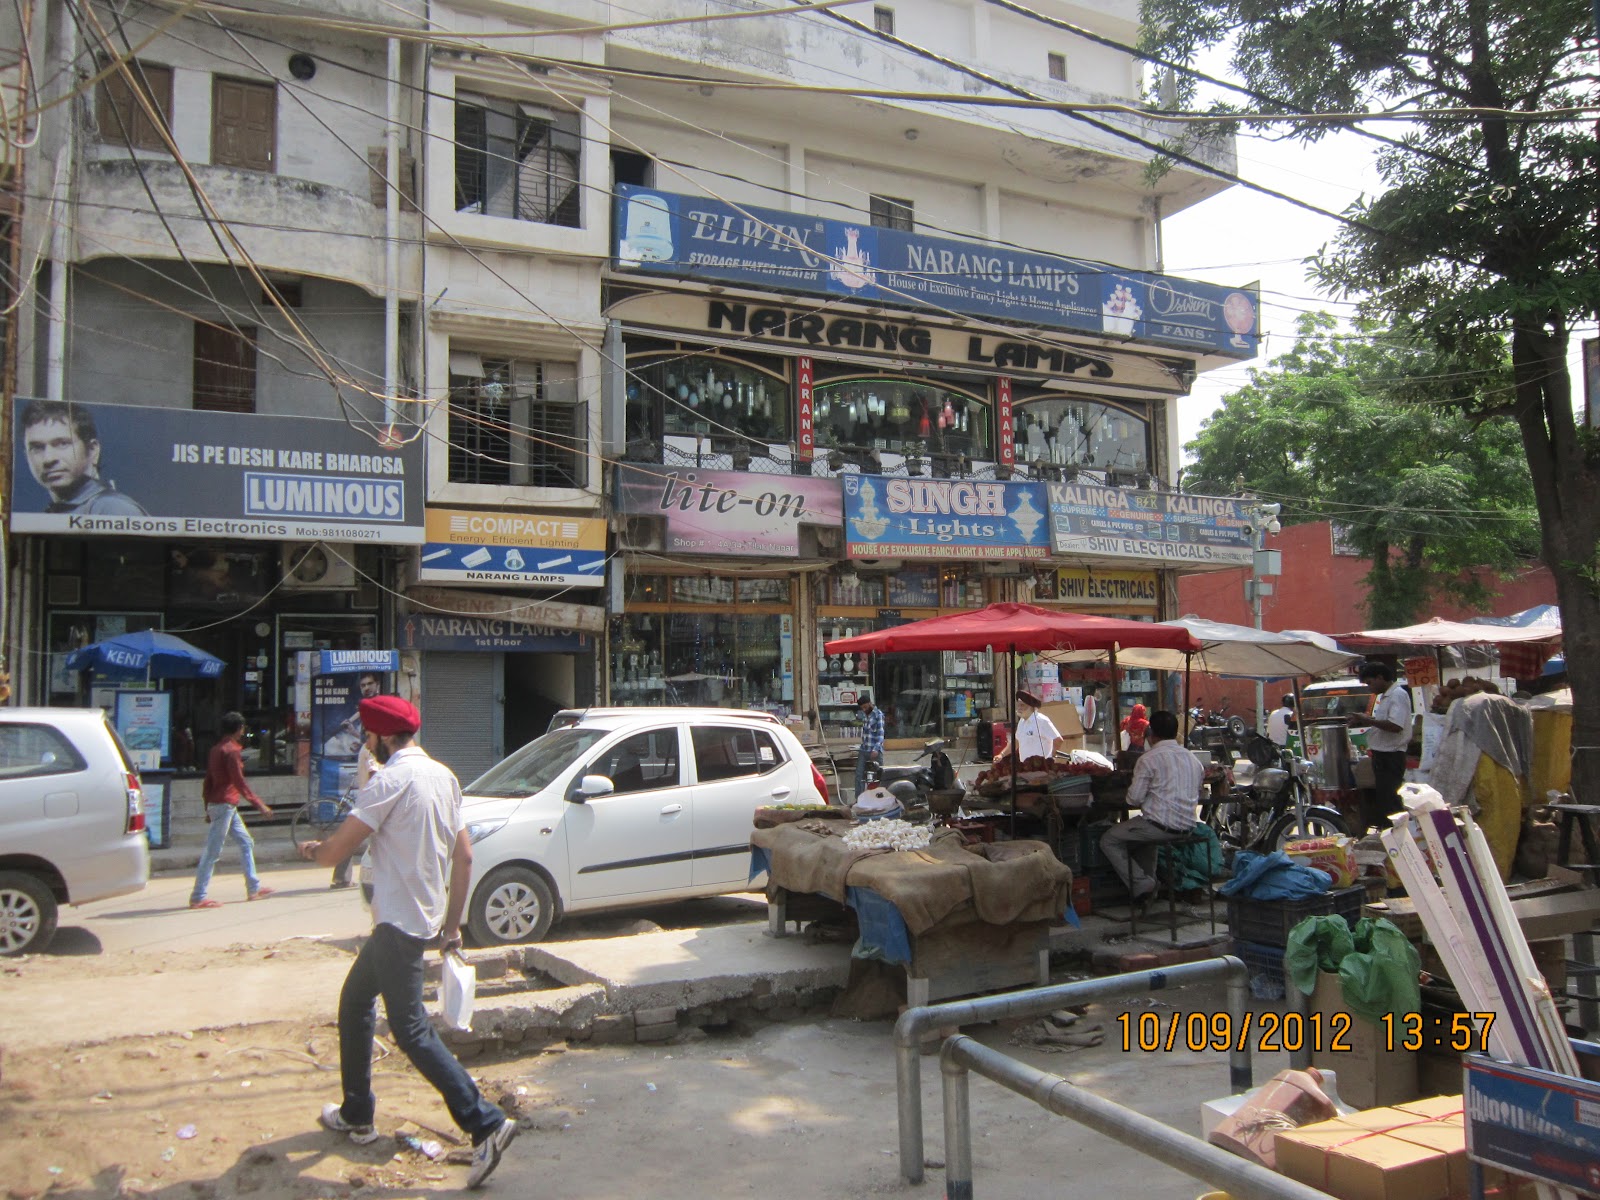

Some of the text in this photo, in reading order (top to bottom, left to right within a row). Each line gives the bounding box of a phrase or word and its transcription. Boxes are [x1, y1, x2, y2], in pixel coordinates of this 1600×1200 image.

[688, 211, 819, 268] ELWIN
[689, 252, 818, 281] STORAGE WATER HEATER
[907, 244, 1079, 295] NARANG LAMPS
[888, 273, 916, 291] House
[918, 279, 927, 292] of
[929, 281, 969, 299] Exclusive
[971, 286, 995, 305] Fancy
[996, 290, 1018, 310] Light
[708, 301, 1114, 378] NARANG LAMPS
[1162, 324, 1204, 340] FANS
[801, 358, 811, 445] NARANG
[1001, 379, 1012, 459] NARANG
[172, 444, 404, 475] JIS PE DESH KARE BHAROSA
[249, 477, 401, 517] LUMINOUS
[659, 471, 807, 518] lite-on
[886, 479, 1007, 516] SINGH
[1051, 485, 1129, 508] KALINGA
[1166, 495, 1236, 518] KALINGA
[69, 515, 381, 539] Kamalsons Electronics Mob:9811080271
[1061, 505, 1097, 515] SUPREME
[1120, 511, 1155, 520] GENUINE
[1173, 515, 1206, 525] SUPREME
[469, 517, 560, 538] COMPACT
[908, 517, 995, 542] Lights
[450, 533, 580, 549] Energy Efficient Lighting
[673, 537, 697, 548] Shop
[769, 543, 794, 553] Nagar
[852, 545, 878, 554] HOUSE
[880, 545, 890, 554] OF
[891, 545, 930, 555] EXCLUSIVE
[932, 546, 954, 556] FANCY
[956, 547, 976, 557] LIGHT
[985, 547, 1005, 557] HOME
[1006, 547, 1046, 558] APPLIANCES
[1060, 541, 1080, 549] Dealer:
[1088, 537, 1119, 552] SHIV
[1123, 540, 1213, 559] ELECTRICALS
[466, 572, 565, 583] NARANG LAMPS
[1060, 578, 1155, 599] SHIV ELECTRICALS
[421, 619, 503, 636] NARANG
[493, 638, 522, 647] Floor
[106, 649, 143, 668] KENT
[332, 650, 391, 664] LUMINOUS
